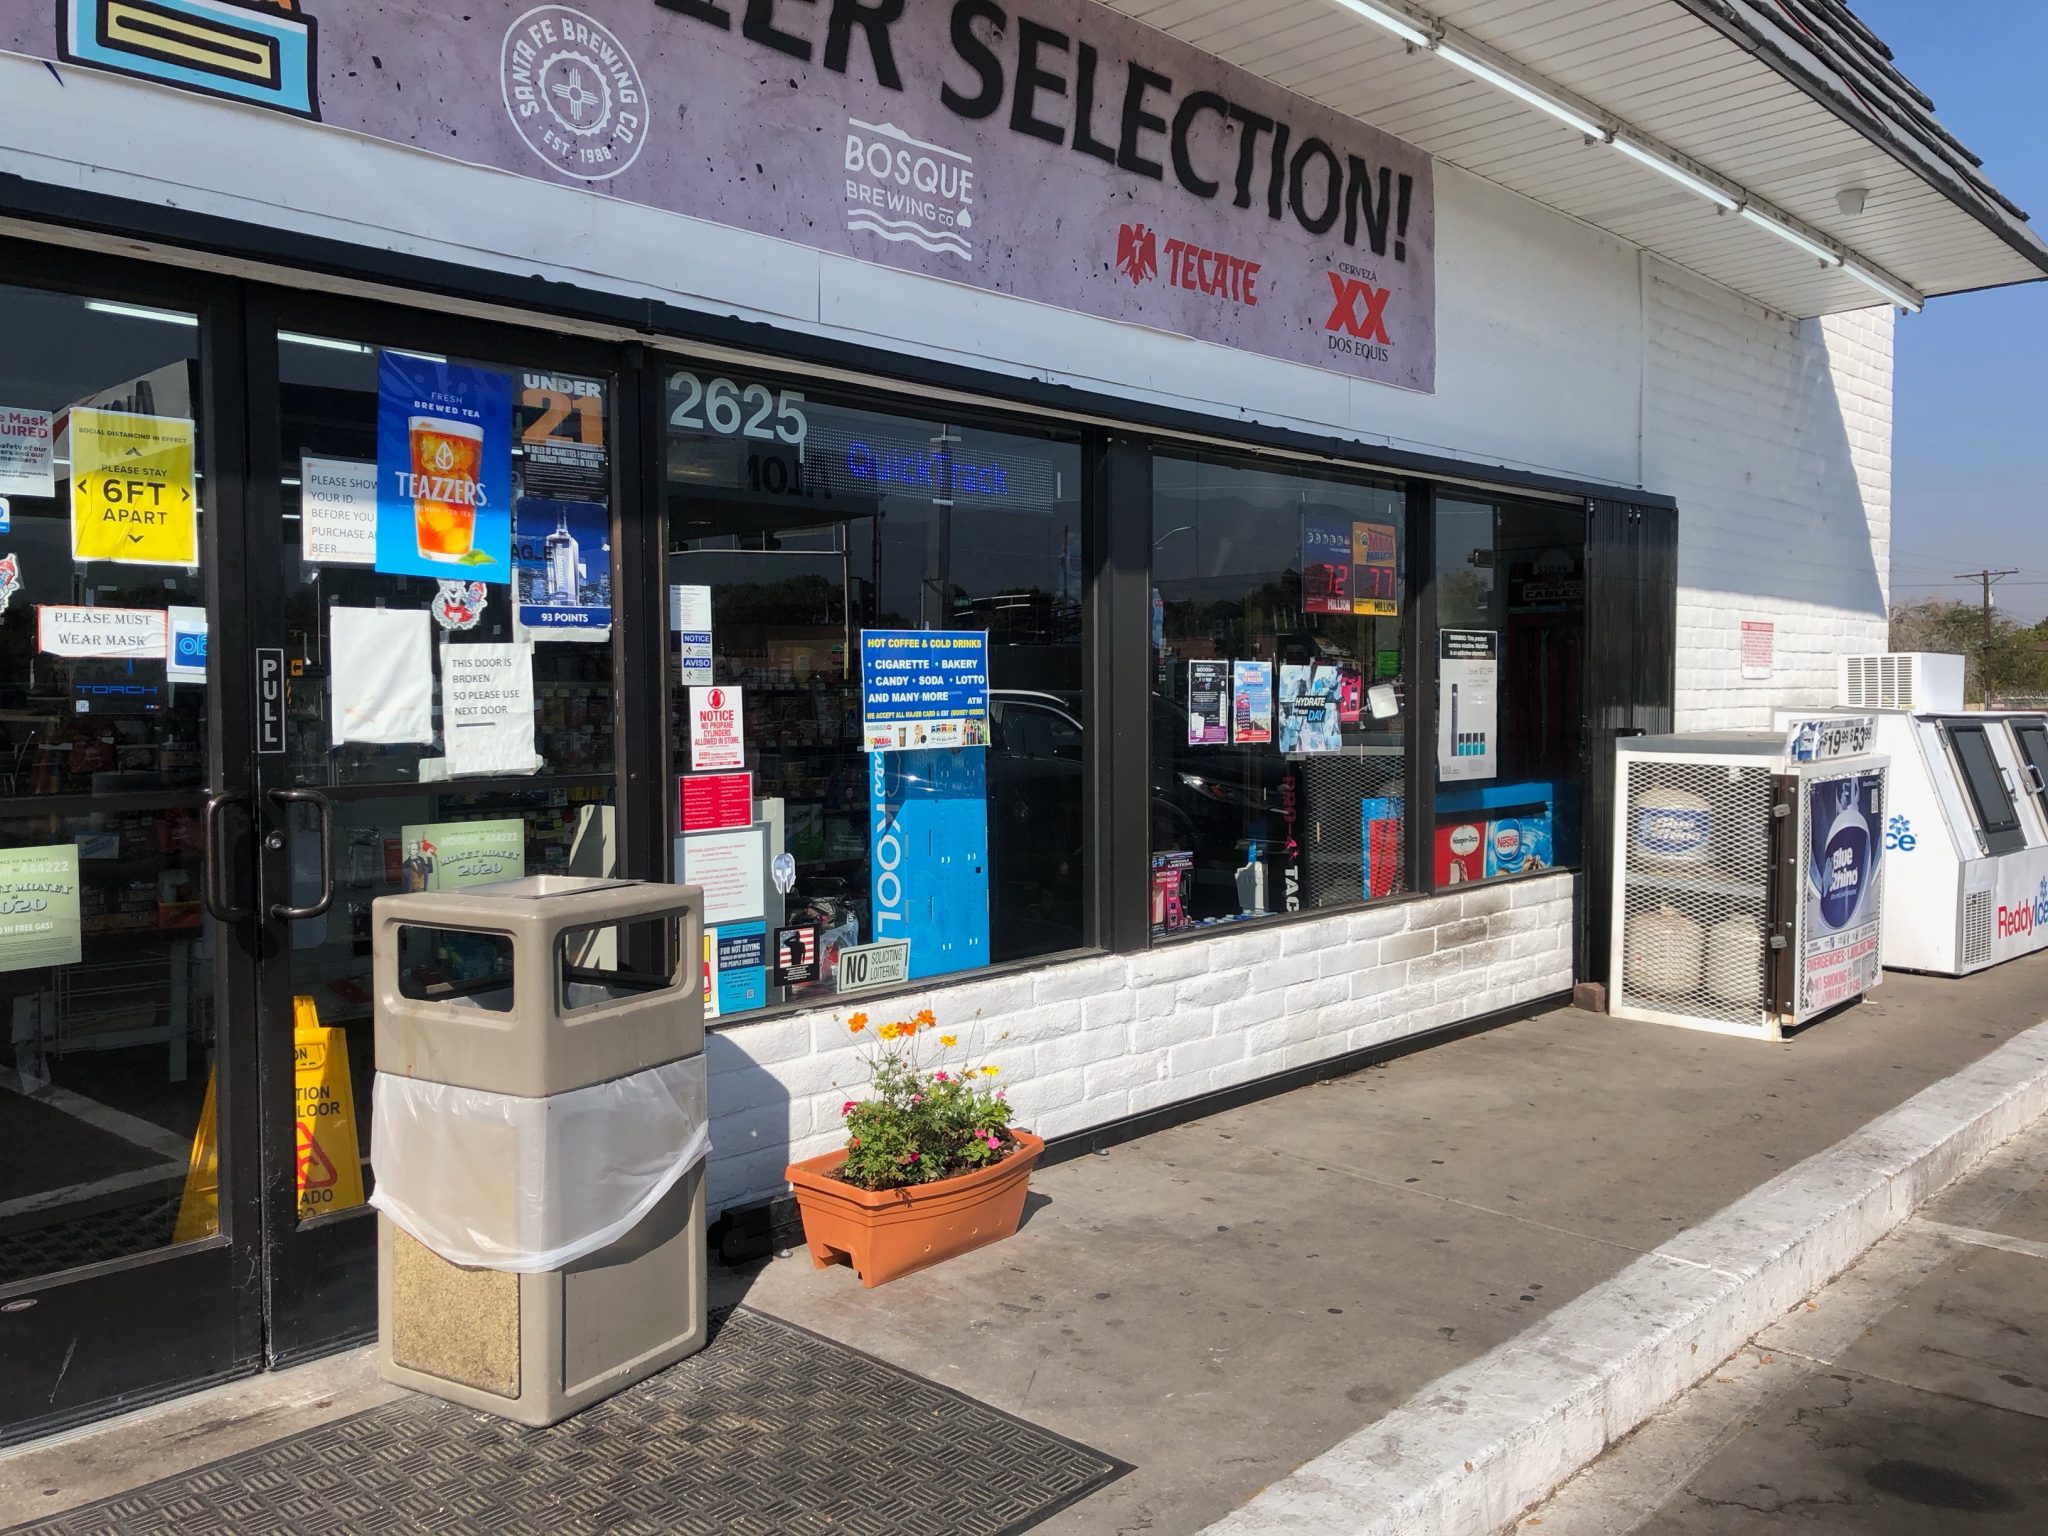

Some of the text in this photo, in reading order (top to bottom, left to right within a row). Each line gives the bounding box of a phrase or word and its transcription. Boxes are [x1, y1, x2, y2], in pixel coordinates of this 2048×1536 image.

[513, 39, 540, 117] SANTA
[528, 19, 557, 49] FE
[561, 18, 638, 104] BREWING
[940, 0, 1413, 263] SELECTION!
[543, 130, 612, 163] EST. 1988
[845, 134, 973, 205] BOSQUE
[846, 180, 954, 227] BREWING CO
[1163, 238, 1263, 307] TECATE
[1338, 261, 1377, 282] CERVEZA
[1325, 271, 1391, 345] XX
[1328, 335, 1389, 363] DOS EQUIS
[523, 373, 601, 398] UNDER
[431, 392, 463, 404] FRESH
[414, 400, 480, 418] BREWED TEA
[670, 371, 808, 444] 2625
[9, 412, 49, 427] Mask
[522, 389, 603, 446] 21
[79, 427, 105, 435] SOCIAL
[107, 430, 151, 440] DISTANCING
[162, 436, 187, 444] EFFECT
[101, 464, 168, 477] PLEASE STAY
[311, 474, 347, 487] PLEASE
[103, 479, 166, 506] 6FT
[395, 471, 488, 507] TEAZZERS
[311, 491, 340, 503] YOUR
[103, 508, 168, 525] APART
[311, 509, 350, 520] BEFORE
[311, 527, 365, 539] PURCHASE
[1324, 563, 1348, 595] 72
[1370, 568, 1393, 596] 77
[1327, 599, 1351, 611] MILLION
[1374, 600, 1396, 613] MILLION
[55, 612, 152, 626] PLEASE MUST
[541, 613, 589, 622] 93 POINTS
[58, 633, 146, 646] WEAR MASK
[684, 634, 710, 643] NOTICE
[867, 639, 982, 648] HOT COFFEE & COLD DRINKS
[452, 658, 512, 668] THIS DOOR IS
[685, 659, 710, 667] AVISO
[875, 660, 978, 670] CIGARETTE BAKERY
[452, 674, 491, 684] BROKEN
[875, 675, 985, 686] CANDY SODA LOTTO
[75, 685, 158, 694] TORCH
[453, 689, 520, 701] SO PLEASE USE
[262, 659, 278, 743] PULL
[868, 691, 949, 703] AND MANY MORE
[967, 697, 983, 705] ATM
[1295, 697, 1326, 707] HYDRATE
[454, 705, 508, 716] NEXT DOOR
[699, 710, 734, 721] NOTICE
[876, 711, 895, 719] ACCEPT
[905, 710, 922, 718] MAJOR
[922, 710, 935, 718] CARD
[1308, 710, 1325, 721] DAY
[701, 721, 734, 730] NO PROPANE
[704, 729, 732, 737] CYLINDERS
[695, 737, 717, 746] ALLOWED
[718, 737, 724, 745] IN
[1833, 847, 1853, 869] Blue
[458, 863, 504, 877] 2020
[876, 803, 902, 933] KOOL
[15, 924, 34, 932] FREE
[35, 922, 53, 930] GAS!
[720, 943, 760, 955] FOR NOT BUYING
[871, 948, 902, 965] SOLICITING
[846, 953, 868, 985] NO
[870, 964, 900, 980] LOITERING
